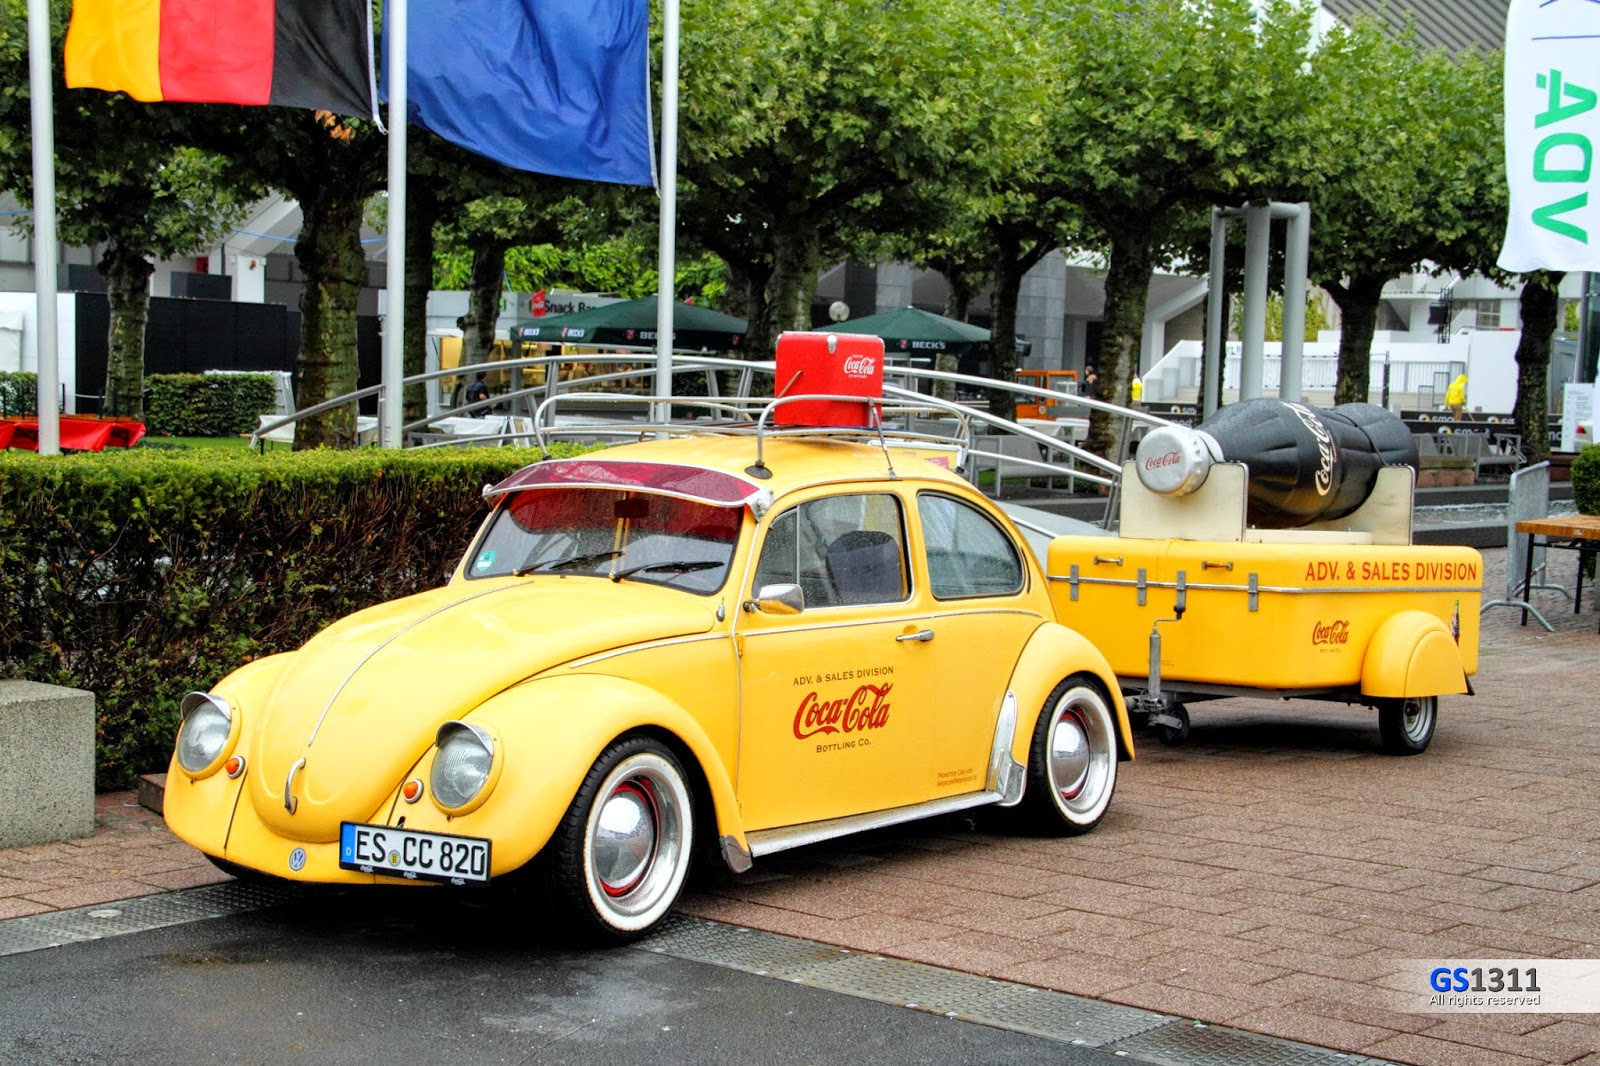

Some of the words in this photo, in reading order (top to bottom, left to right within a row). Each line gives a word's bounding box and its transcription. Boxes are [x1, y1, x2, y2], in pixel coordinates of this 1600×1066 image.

[544, 300, 576, 314] Snack
[912, 340, 946, 349] BECK'S
[1305, 562, 1340, 581] ADV.
[1346, 561, 1356, 580] &
[1362, 562, 1410, 581] SALES
[1416, 562, 1477, 581] DIVISION
[793, 676, 813, 686] ADV.
[816, 674, 823, 683] &
[825, 670, 854, 682] SALES
[856, 666, 894, 679] DIVISION
[356, 830, 387, 863] ES
[403, 837, 433, 869] CC
[440, 841, 486, 876] 820
